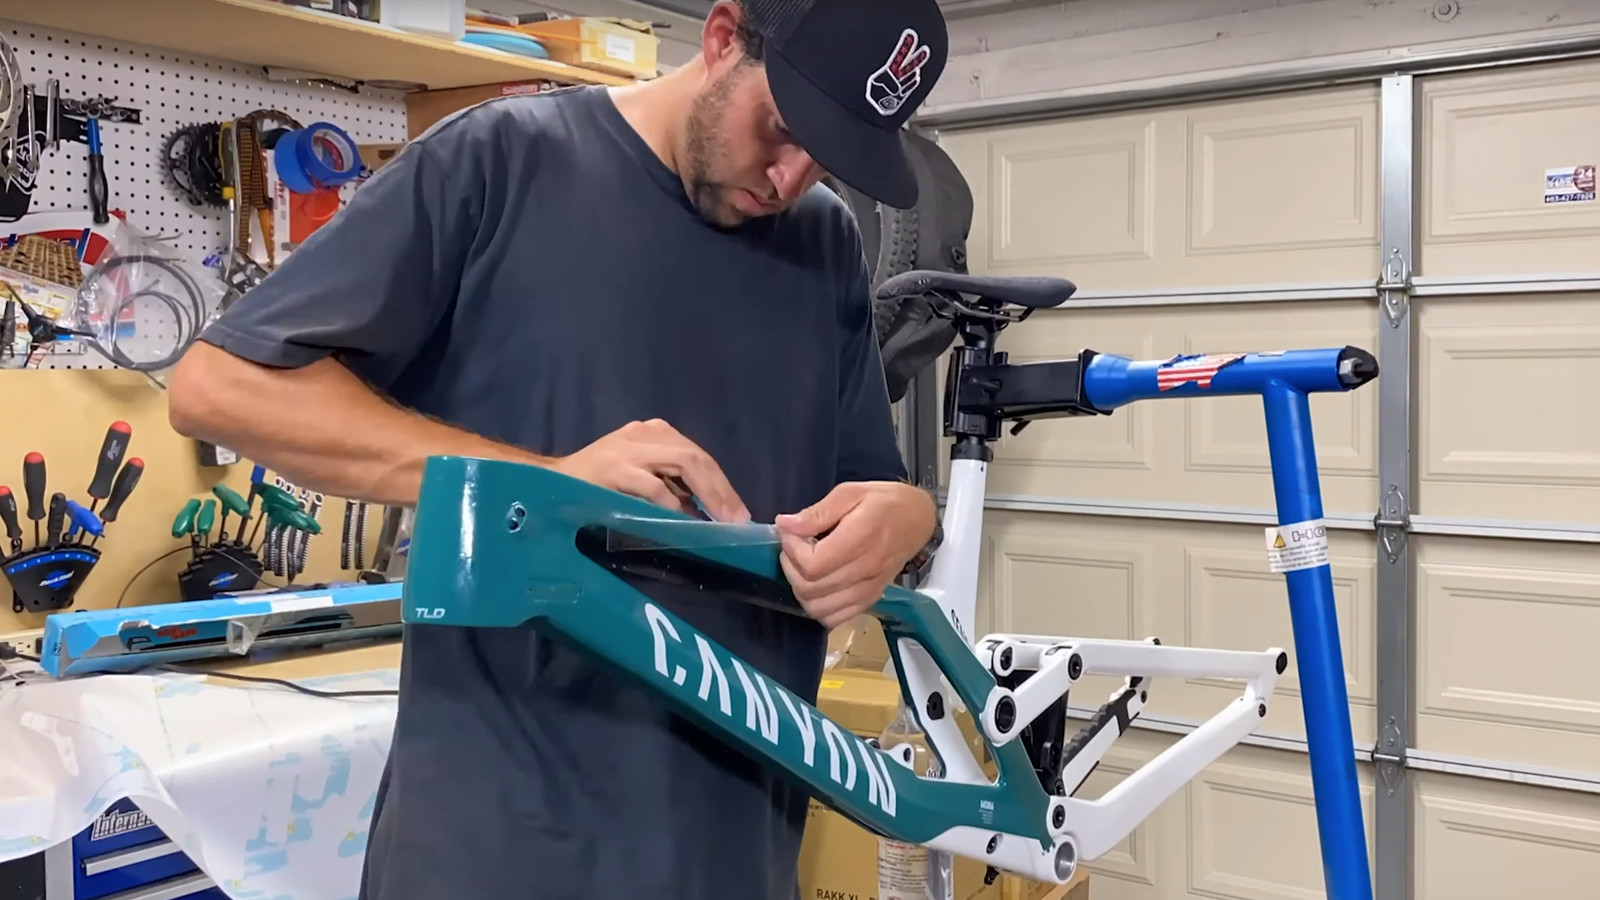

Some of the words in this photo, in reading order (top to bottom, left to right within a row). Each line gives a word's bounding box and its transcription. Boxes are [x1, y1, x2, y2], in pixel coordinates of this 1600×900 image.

[415, 607, 446, 619] TLD
[644, 602, 897, 818] CANYON
[93, 810, 153, 839] Interna
